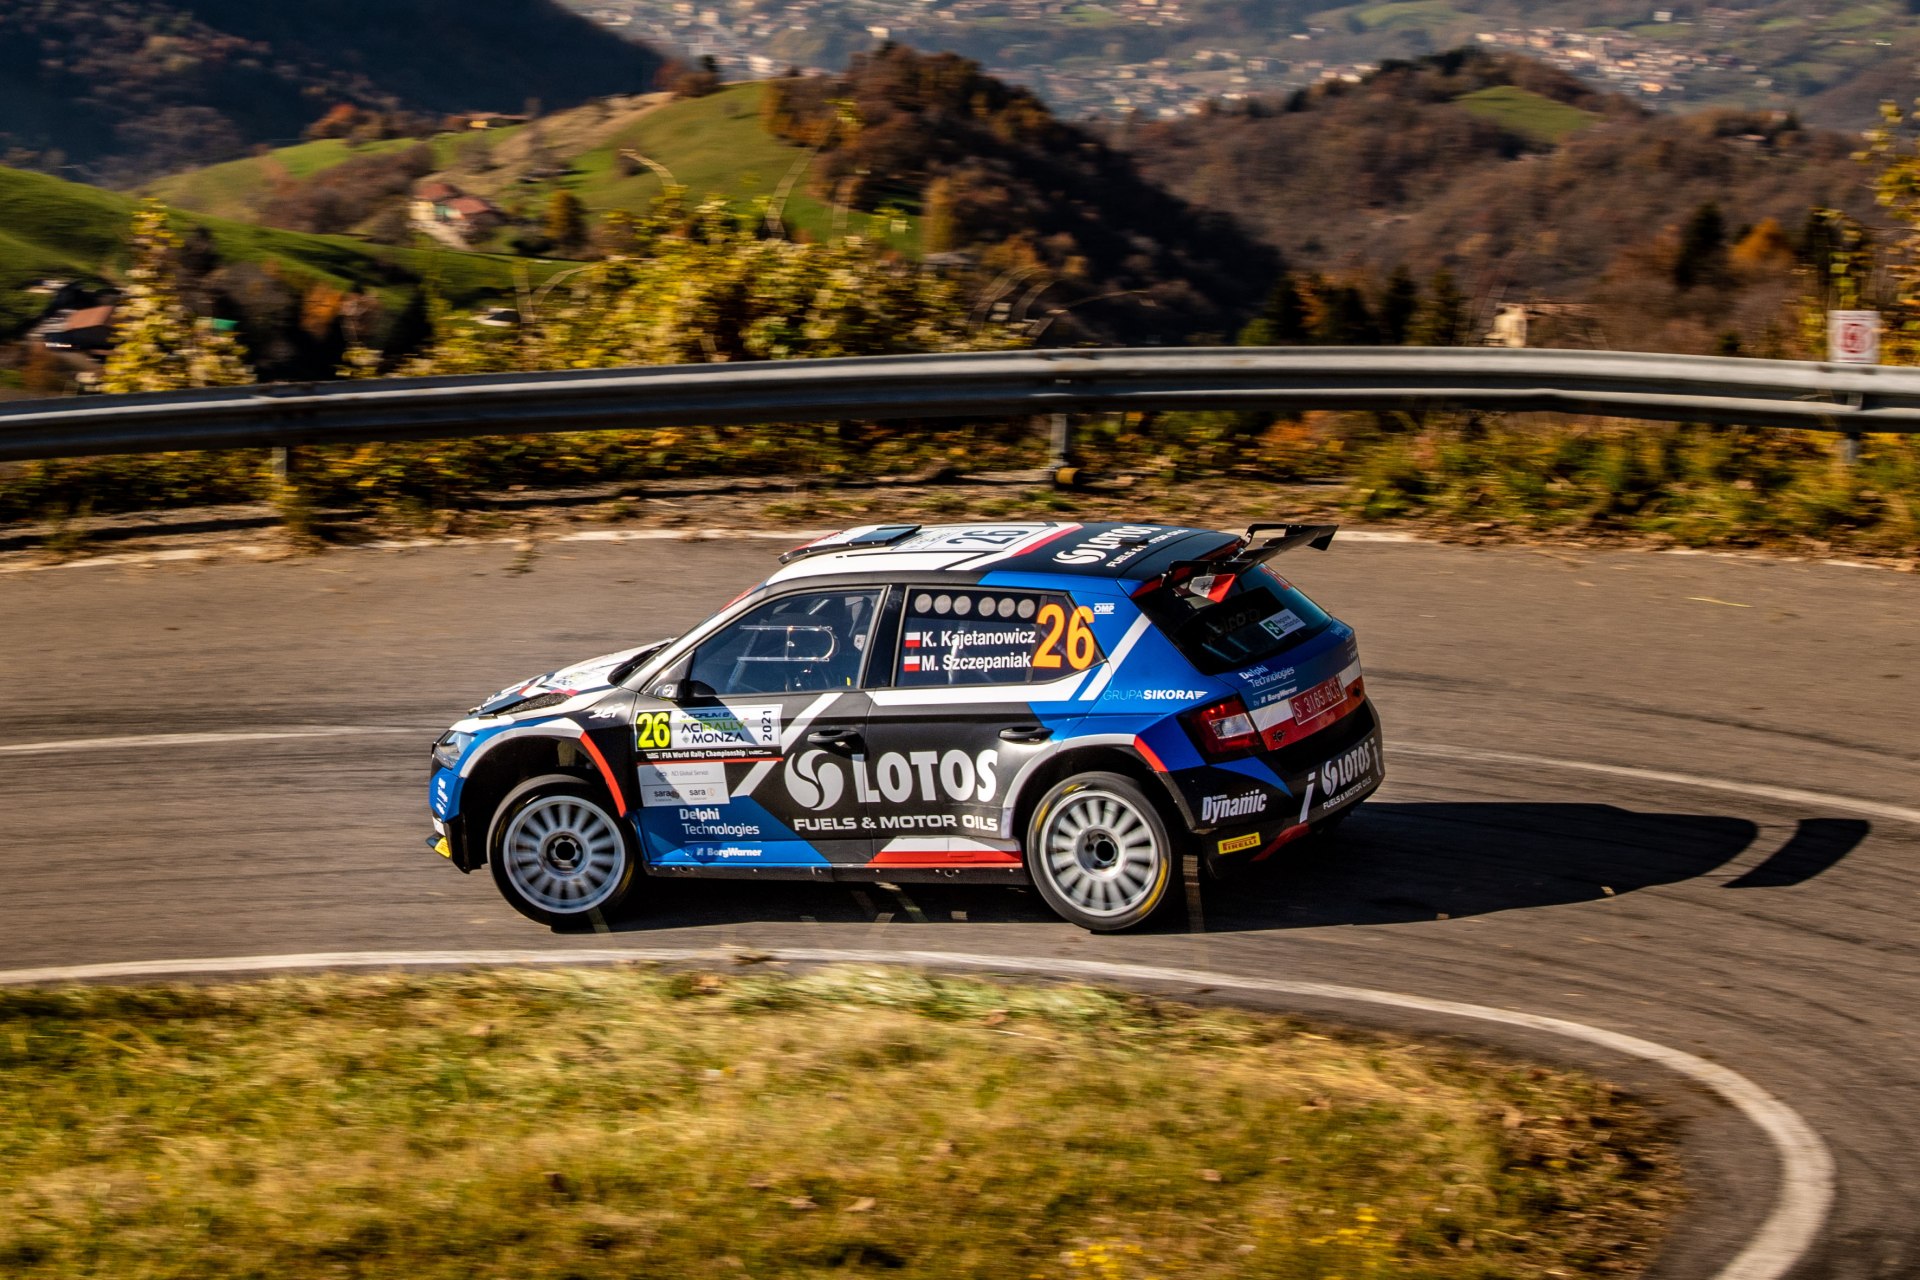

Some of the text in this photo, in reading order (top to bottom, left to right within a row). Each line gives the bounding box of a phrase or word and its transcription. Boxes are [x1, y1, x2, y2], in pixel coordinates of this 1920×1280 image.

[1094, 604, 1115, 614] OMP
[922, 628, 1036, 650] K. Kajetanowicz
[1032, 603, 1096, 671] 26
[921, 652, 1032, 673] M. Szczepaniak
[1238, 664, 1269, 680] Delphi
[1247, 666, 1296, 688] Technologies
[1293, 701, 1303, 718] S
[1303, 689, 1326, 713] 3165
[637, 712, 671, 748] 26
[762, 710, 773, 742] 2021
[691, 732, 745, 744] MONZA
[690, 751, 705, 760] Rally
[706, 750, 746, 759] Championship
[1338, 742, 1371, 787] LOTOS
[852, 749, 998, 803] LOTOS
[1201, 789, 1268, 824] Dynamic
[1323, 795, 1341, 810] FUELS
[1344, 782, 1363, 799] MOTOR
[679, 808, 720, 822] Delphi
[793, 814, 998, 832] FUELS & MOTOR OILS
[681, 822, 760, 837] Technologies
[706, 847, 762, 859] BorgWarner
[1222, 835, 1257, 852] PIRELLI
